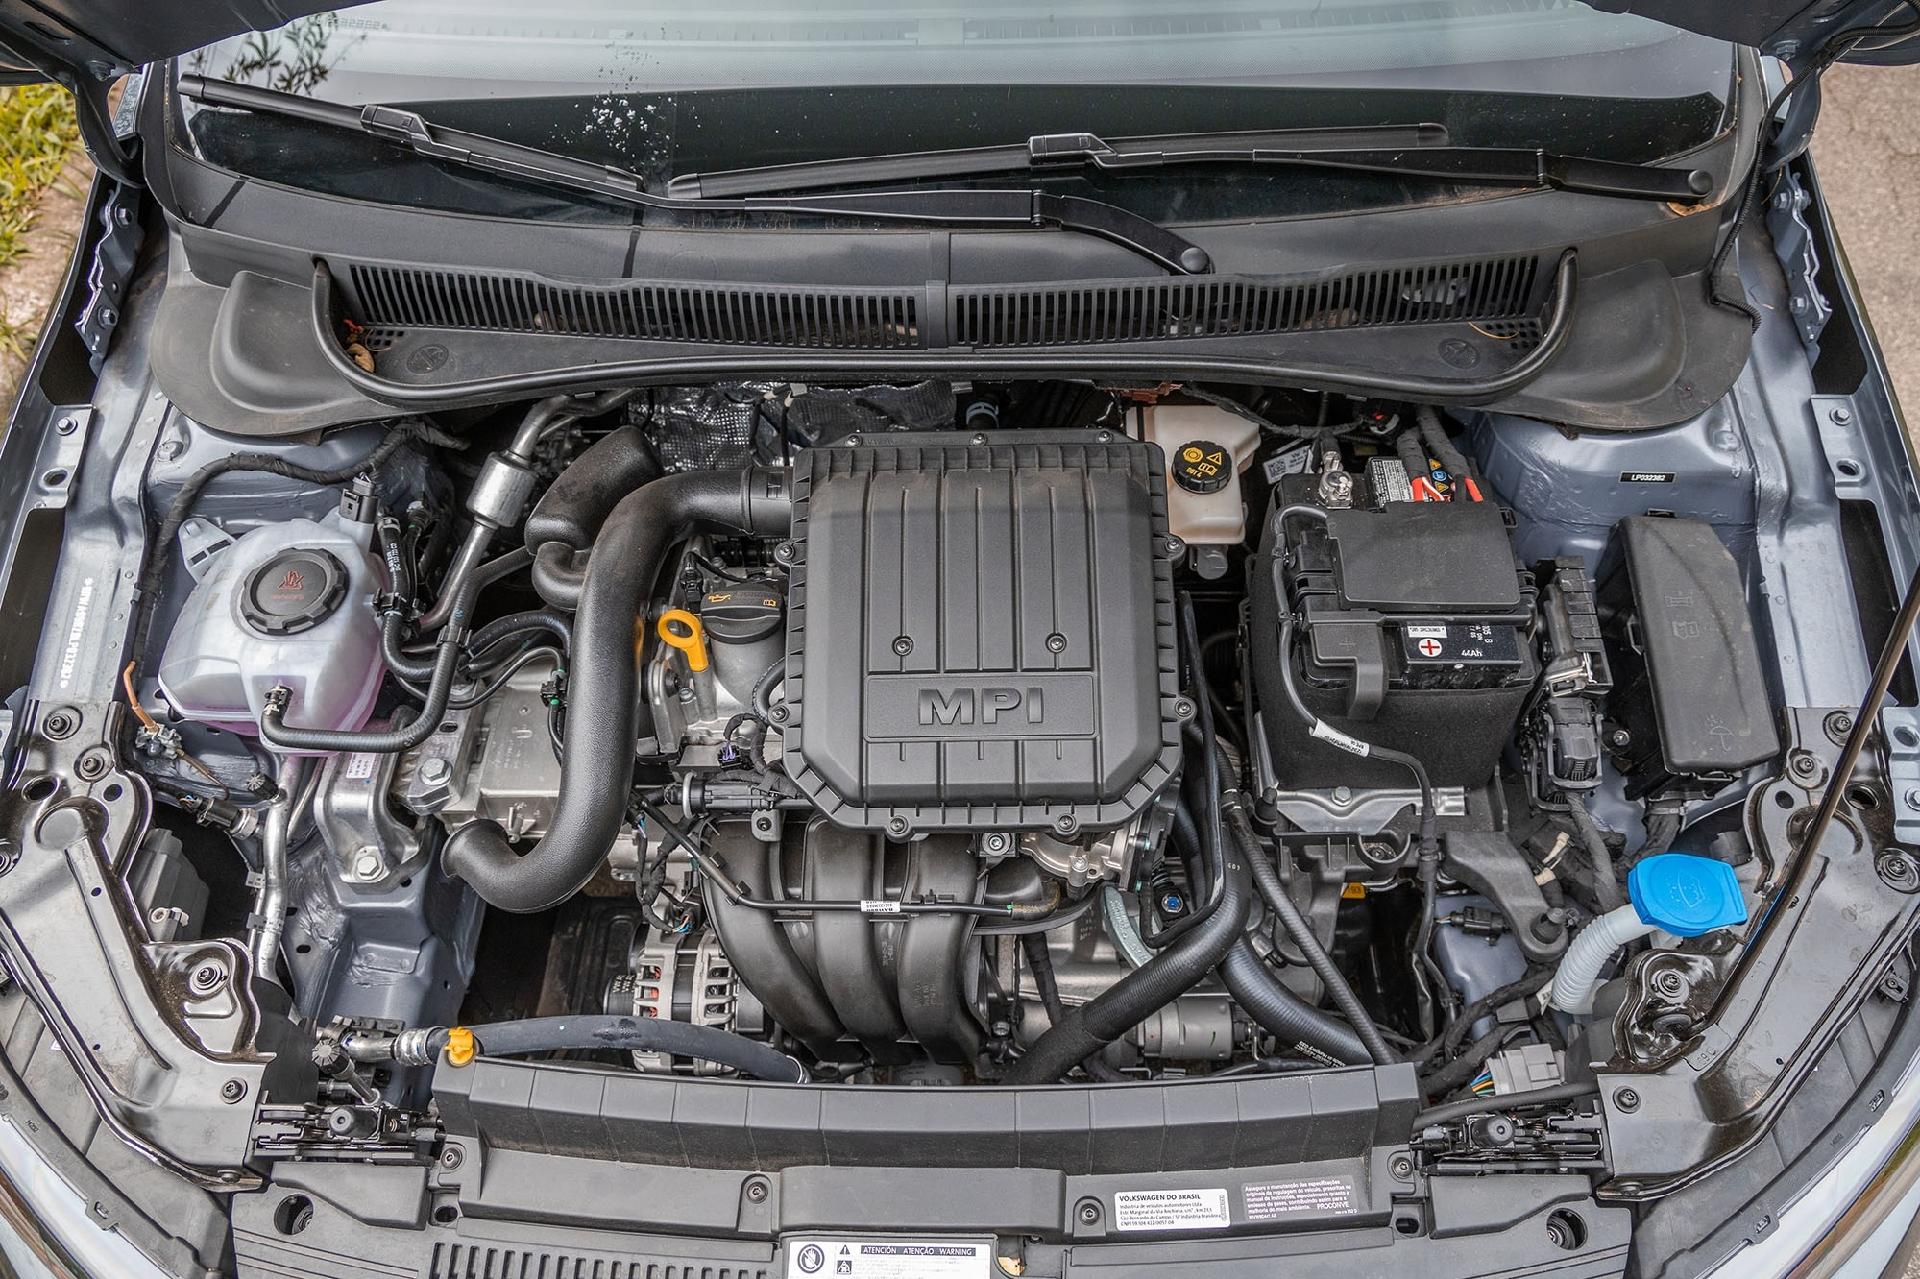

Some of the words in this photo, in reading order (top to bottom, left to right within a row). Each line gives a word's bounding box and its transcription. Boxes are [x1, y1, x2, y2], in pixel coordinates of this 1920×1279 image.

[1186, 466, 1197, 476] DOT
[1461, 648, 1483, 657] 44Ah
[918, 687, 1044, 725] MPI
[1119, 1194, 1165, 1202] VOLKSWAGEN
[862, 1245, 897, 1255] ATENCIÓN
[903, 1245, 935, 1256] ATENÇÃO
[939, 1247, 973, 1256] WARNING
